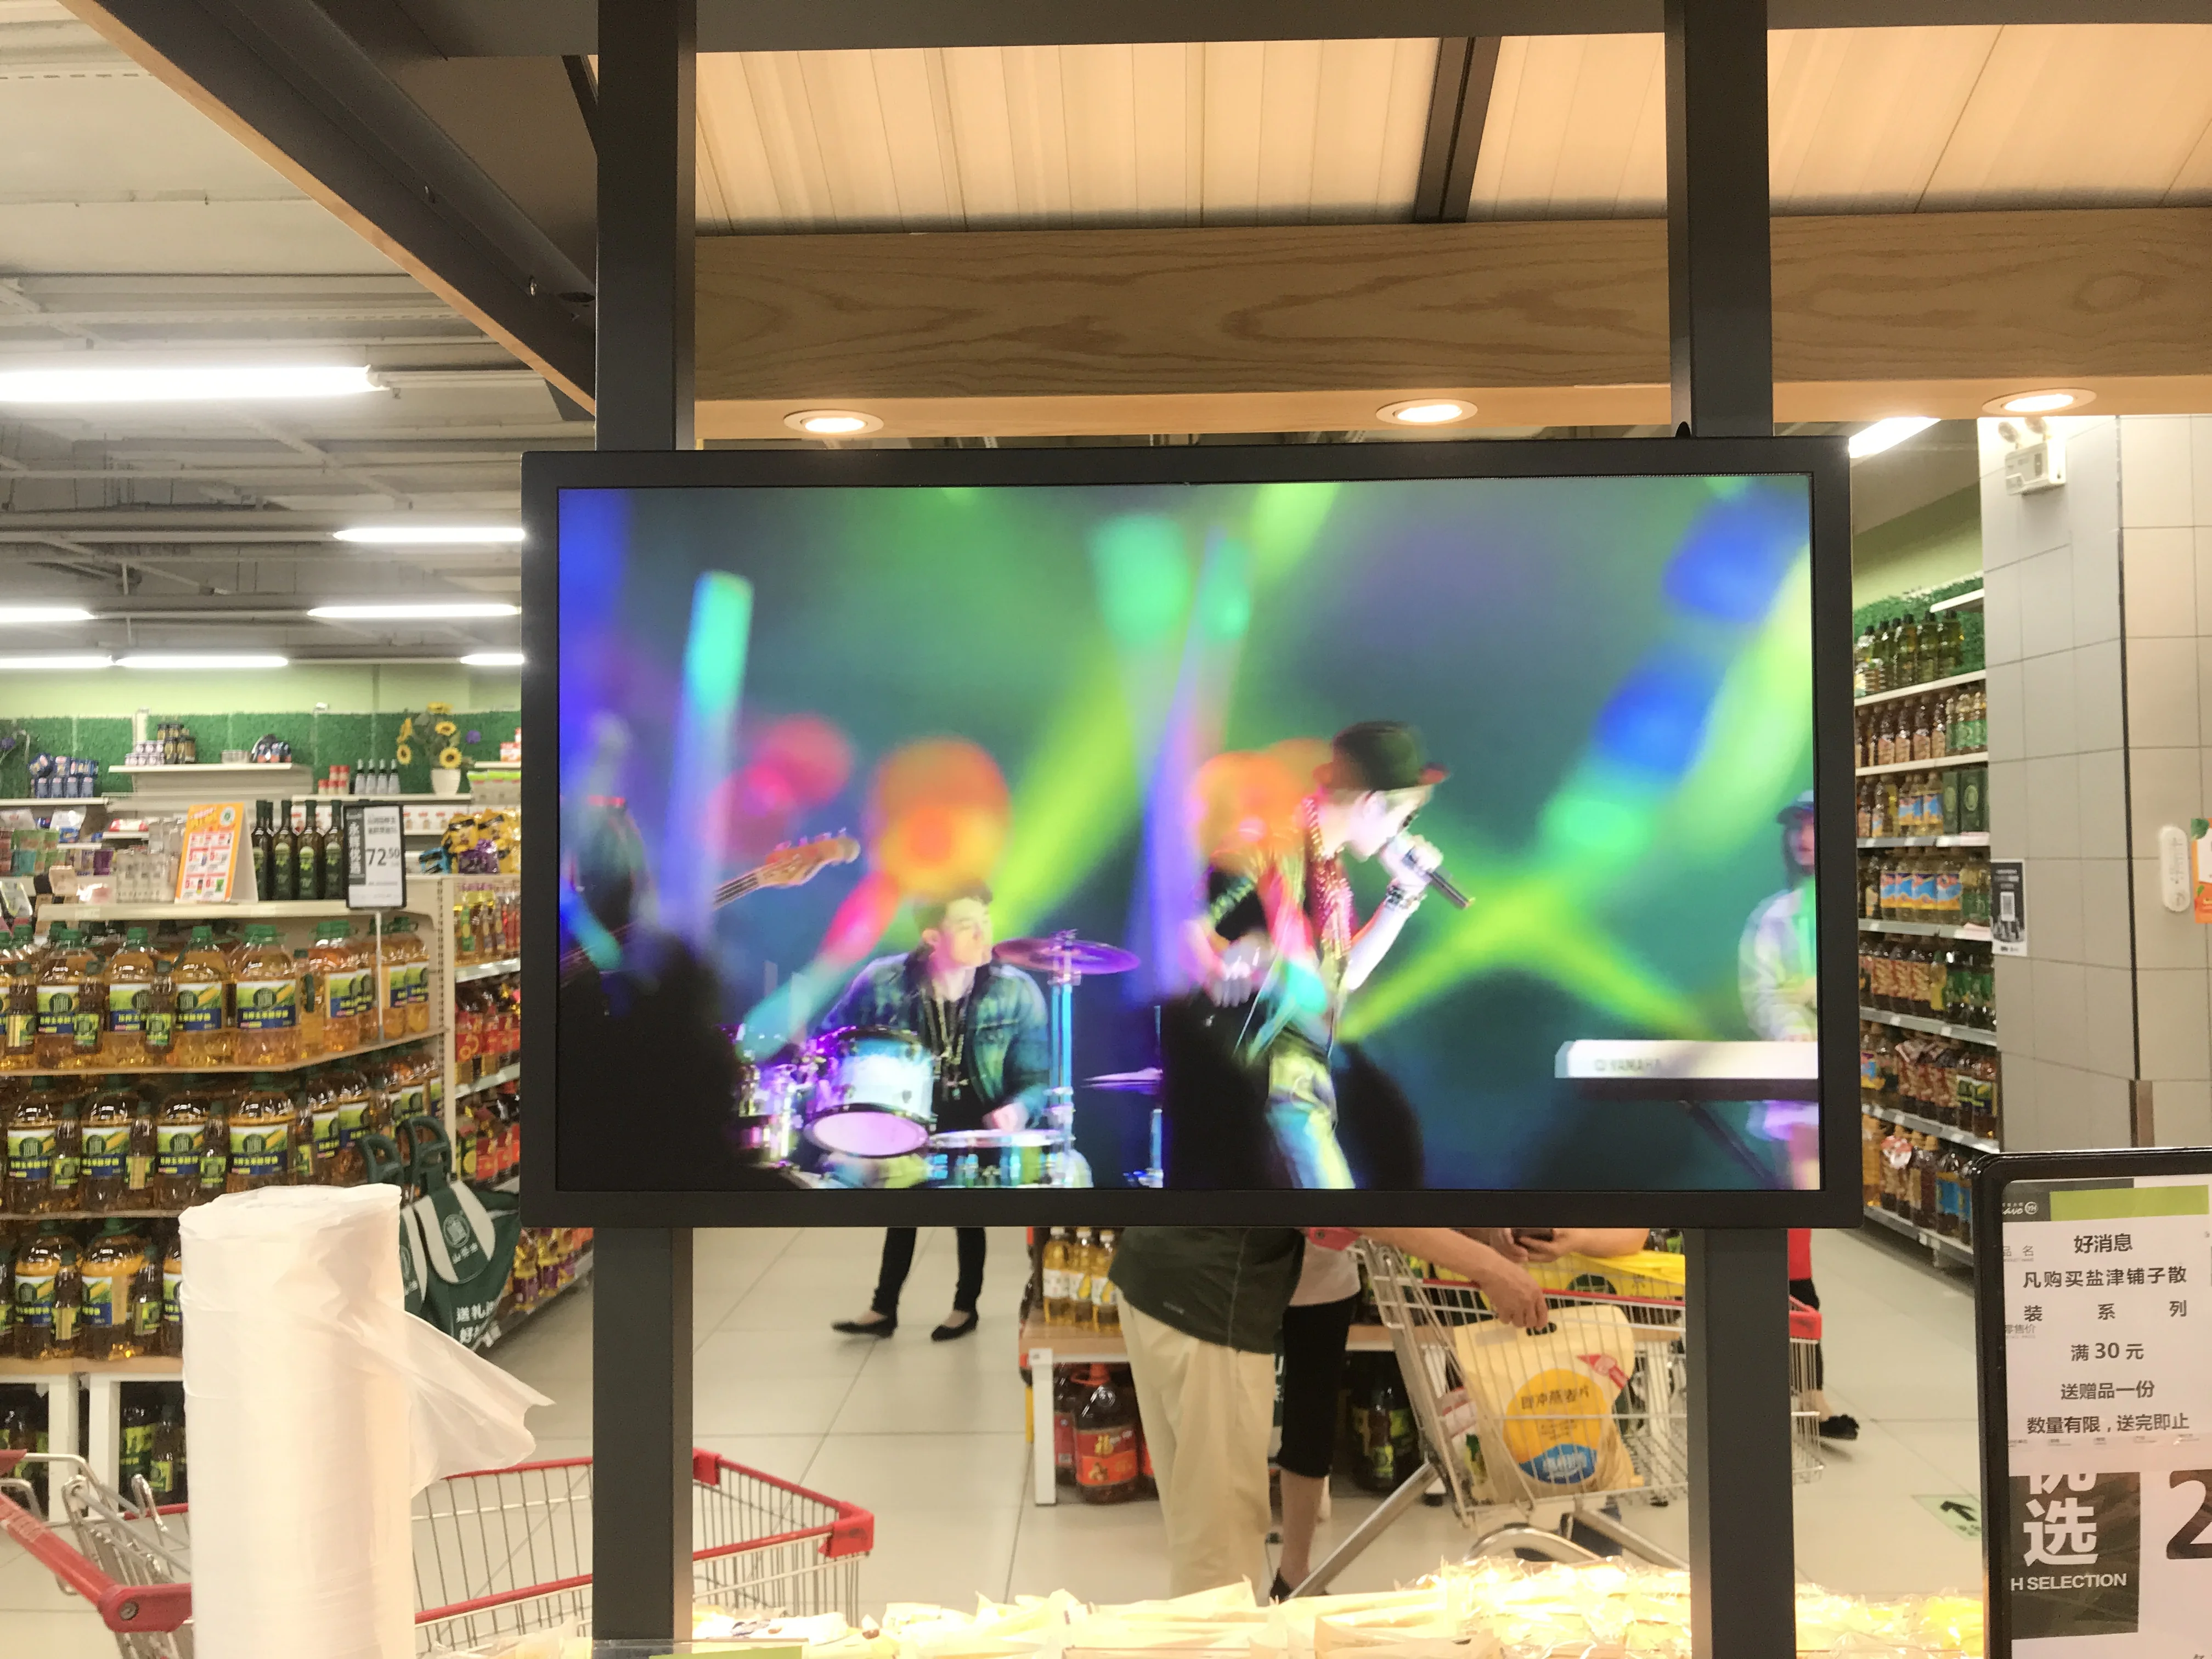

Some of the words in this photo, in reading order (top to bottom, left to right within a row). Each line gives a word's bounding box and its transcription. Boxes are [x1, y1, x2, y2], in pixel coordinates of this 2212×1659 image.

[2074, 1233, 2133, 1254] 好消息
[2023, 1266, 2187, 1289] 凡购买盐津铺子散
[2061, 1380, 2155, 1400] 送赠品一份
[2023, 1474, 2099, 1567] 选
[2027, 1572, 2127, 1590] SELECTION
